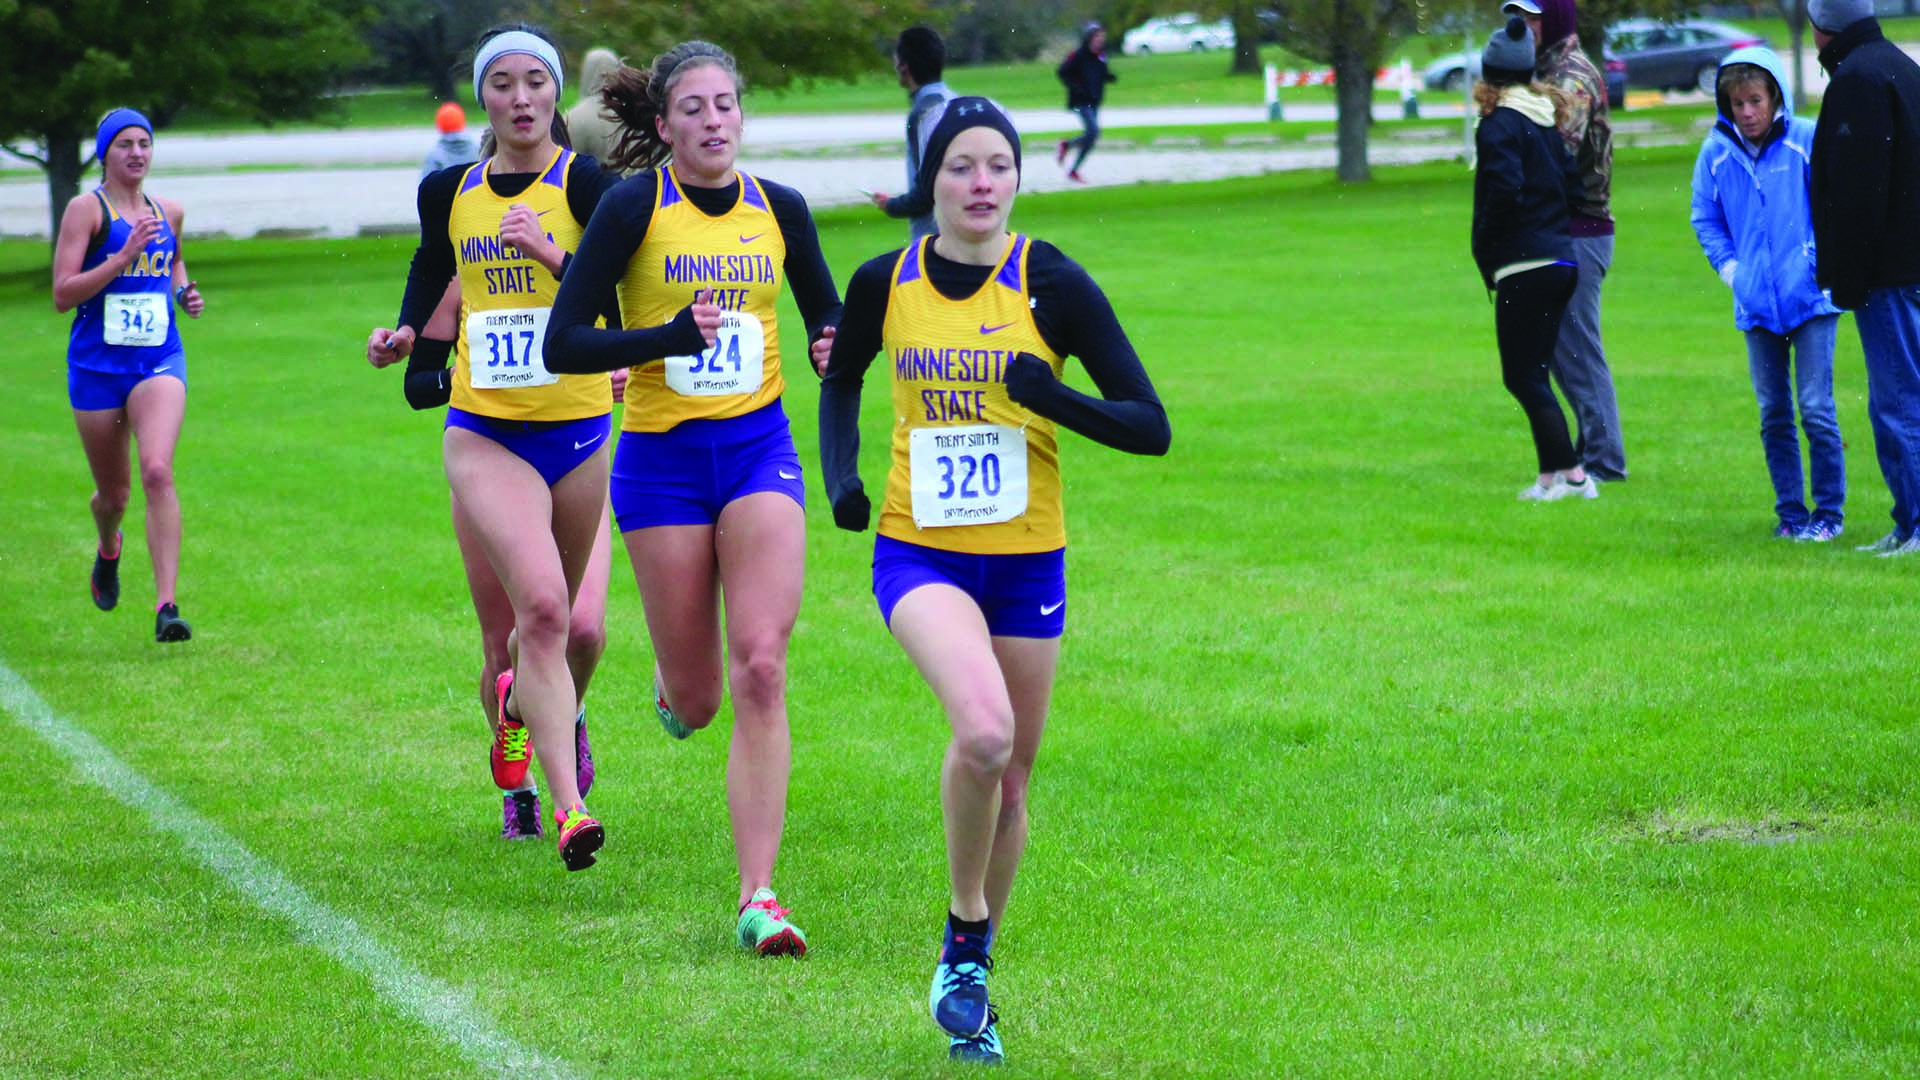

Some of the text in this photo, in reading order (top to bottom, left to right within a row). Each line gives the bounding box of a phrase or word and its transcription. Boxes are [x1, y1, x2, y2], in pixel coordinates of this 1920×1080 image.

[484, 266, 536, 295] STATE
[664, 254, 775, 285] MINNESOTA
[120, 309, 154, 333] 342
[509, 314, 535, 326] SMITH
[486, 331, 535, 367] 317
[491, 372, 534, 383] INVITATIONAL
[693, 379, 739, 390] INVITATIONAL
[921, 389, 988, 422] STATE
[934, 432, 999, 449] TRENT SMITH
[936, 453, 1001, 500] 320
[944, 505, 999, 519] INVITATIONAL
